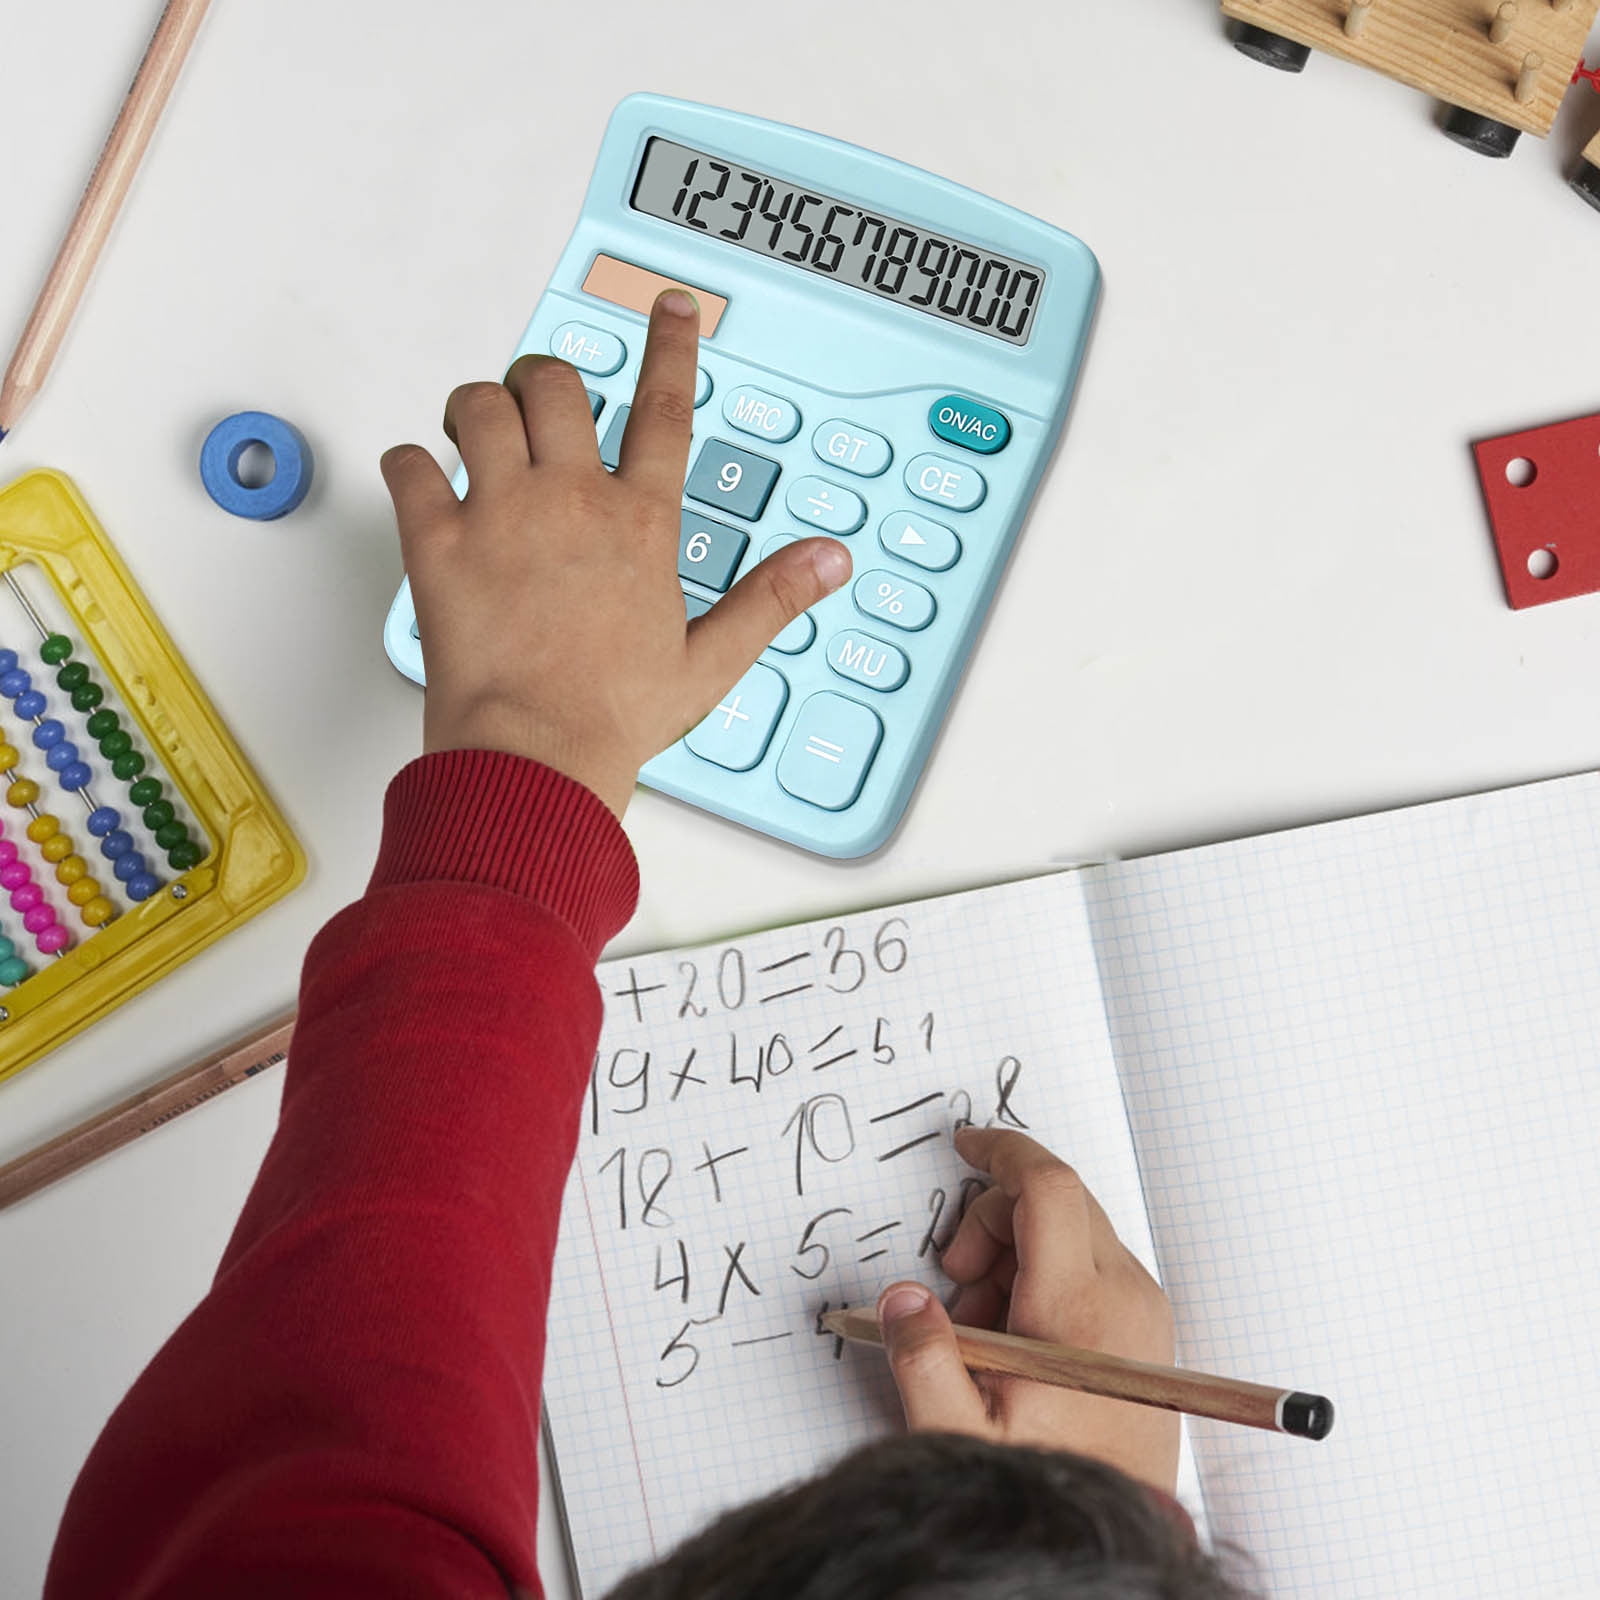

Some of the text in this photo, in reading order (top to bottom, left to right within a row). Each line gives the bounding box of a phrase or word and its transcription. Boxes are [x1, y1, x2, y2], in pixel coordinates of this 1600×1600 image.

[559, 331, 603, 361] M+
[732, 396, 783, 431] MRC
[937, 406, 998, 442] ON/AC
[827, 433, 869, 462] GT
[716, 462, 743, 492] 9
[919, 466, 962, 500] CE
[685, 532, 712, 563] 6
[838, 639, 888, 678] MU
